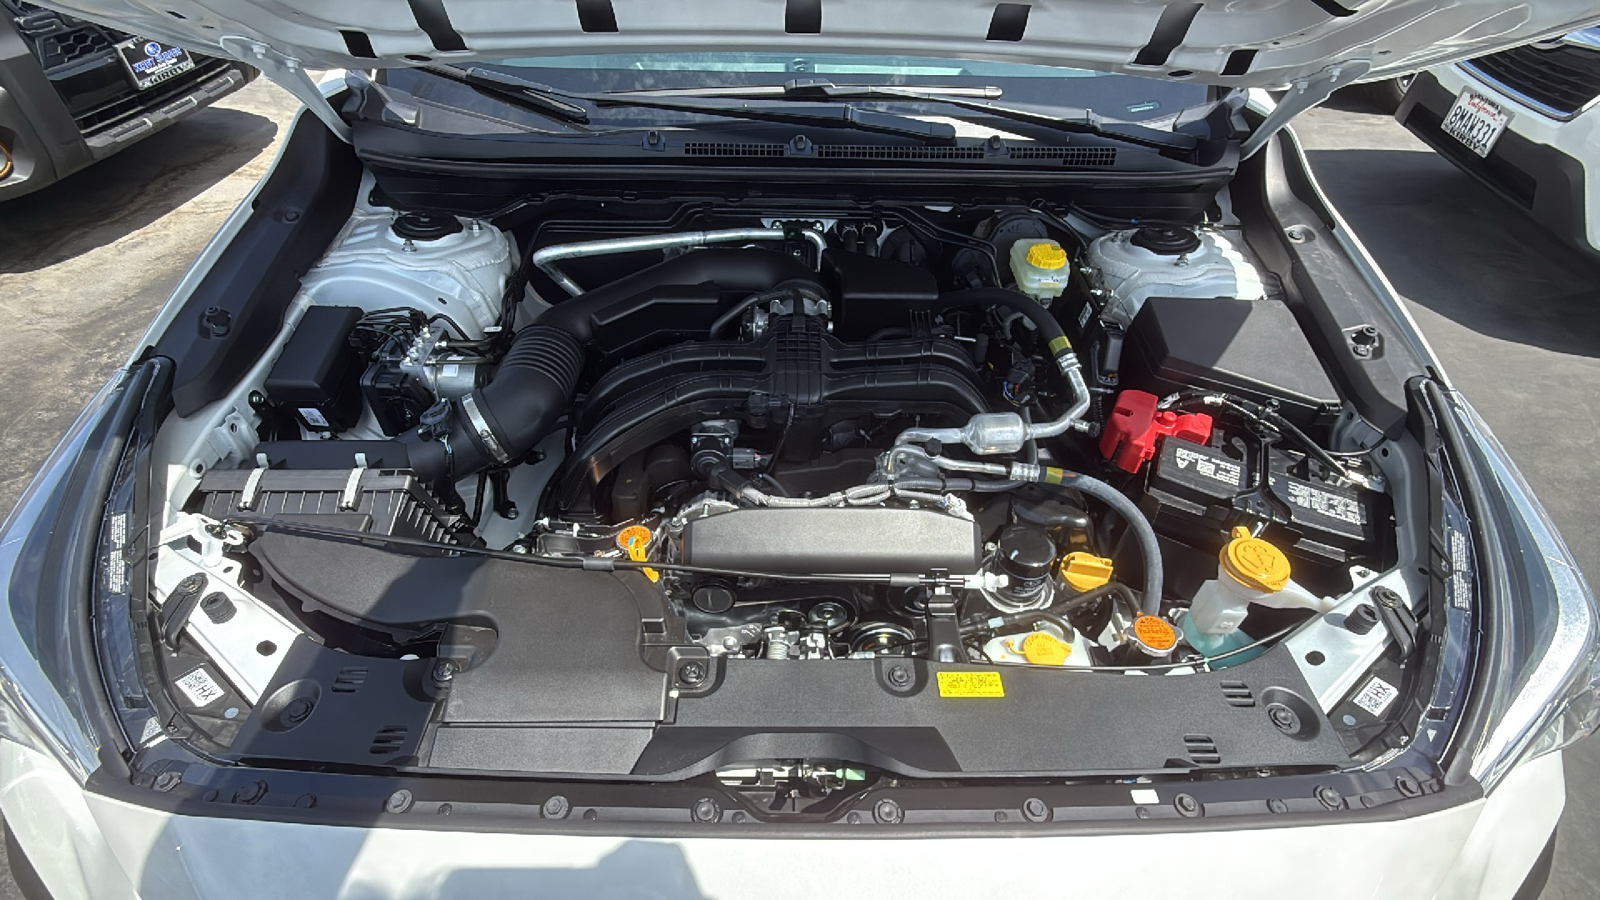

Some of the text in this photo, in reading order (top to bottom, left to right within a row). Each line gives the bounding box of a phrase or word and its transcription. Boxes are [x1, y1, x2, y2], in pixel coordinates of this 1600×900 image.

[149, 65, 184, 84] KIRBY
[1449, 105, 1497, 144] 8MAW331
[1449, 127, 1480, 150] KIRBY
